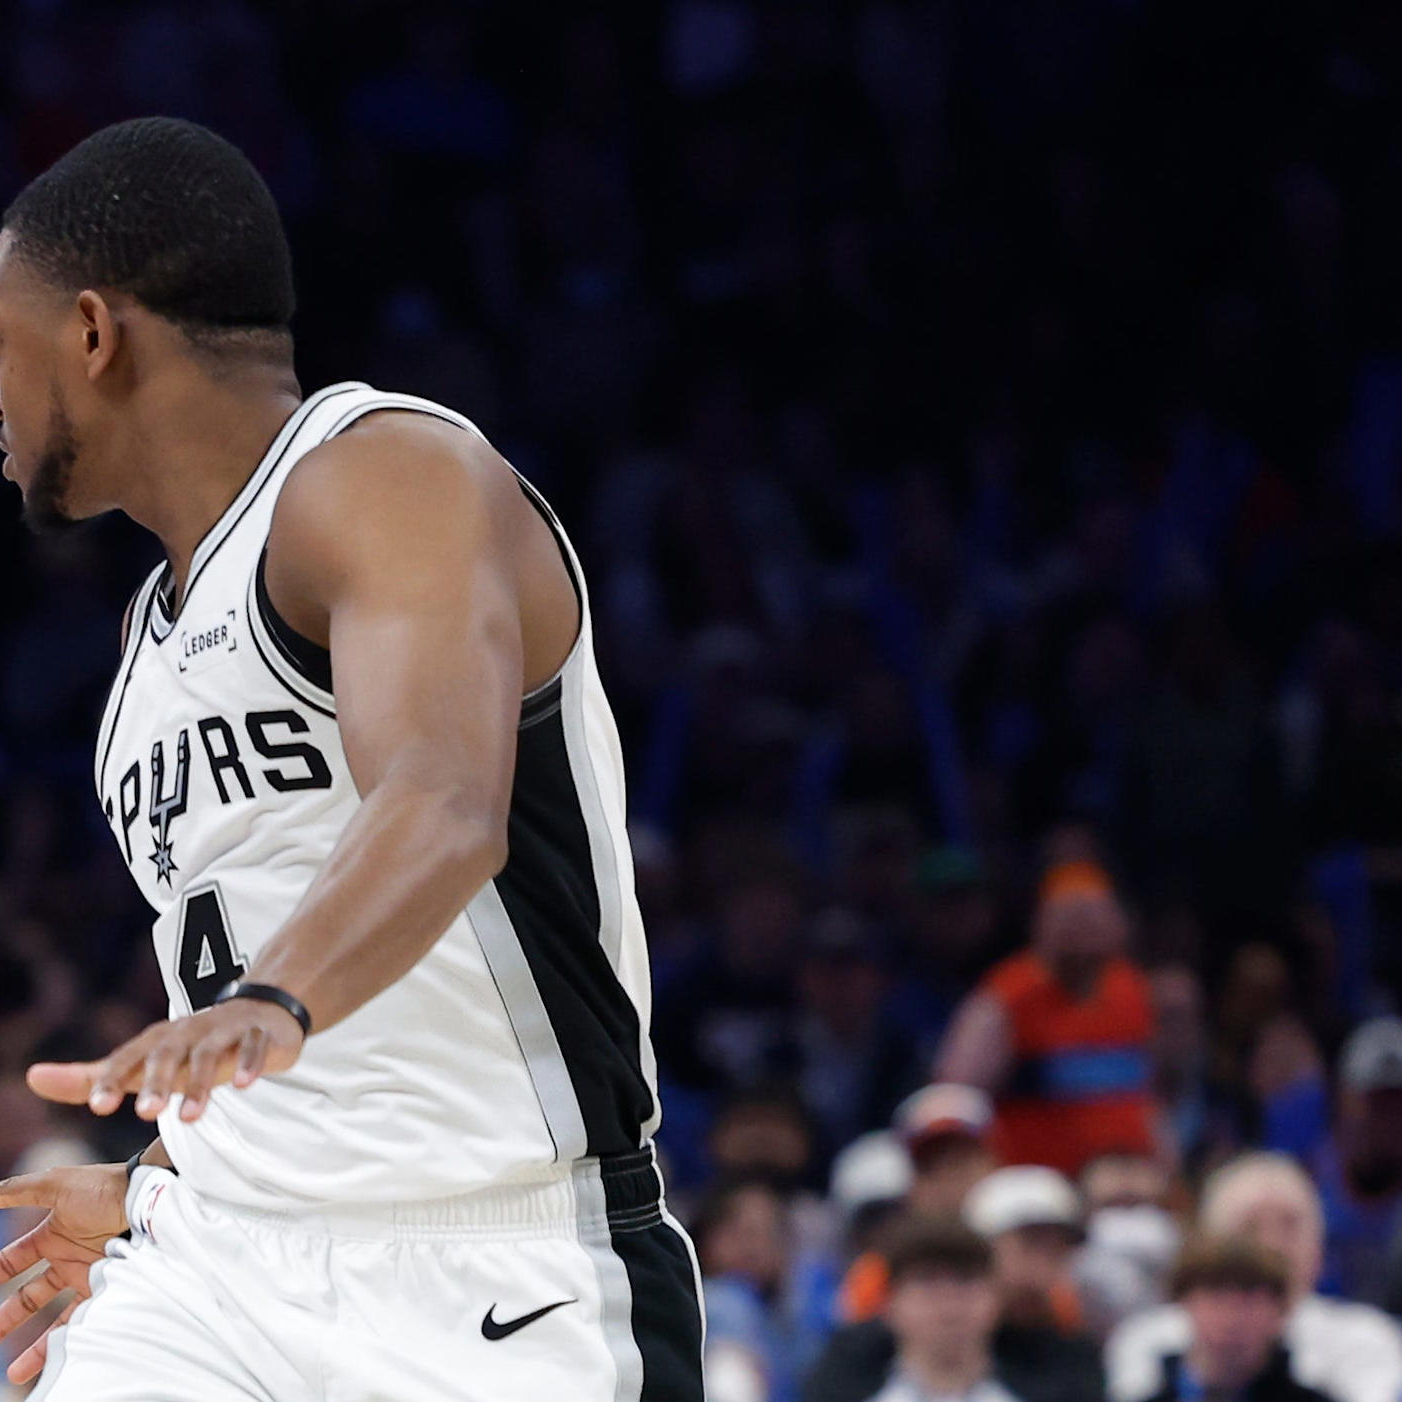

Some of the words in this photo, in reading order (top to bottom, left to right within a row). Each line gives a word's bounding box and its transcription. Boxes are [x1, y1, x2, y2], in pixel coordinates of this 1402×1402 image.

[183, 624, 228, 658] LEDGER
[105, 709, 333, 889] PURS
[174, 879, 251, 1014] 4
